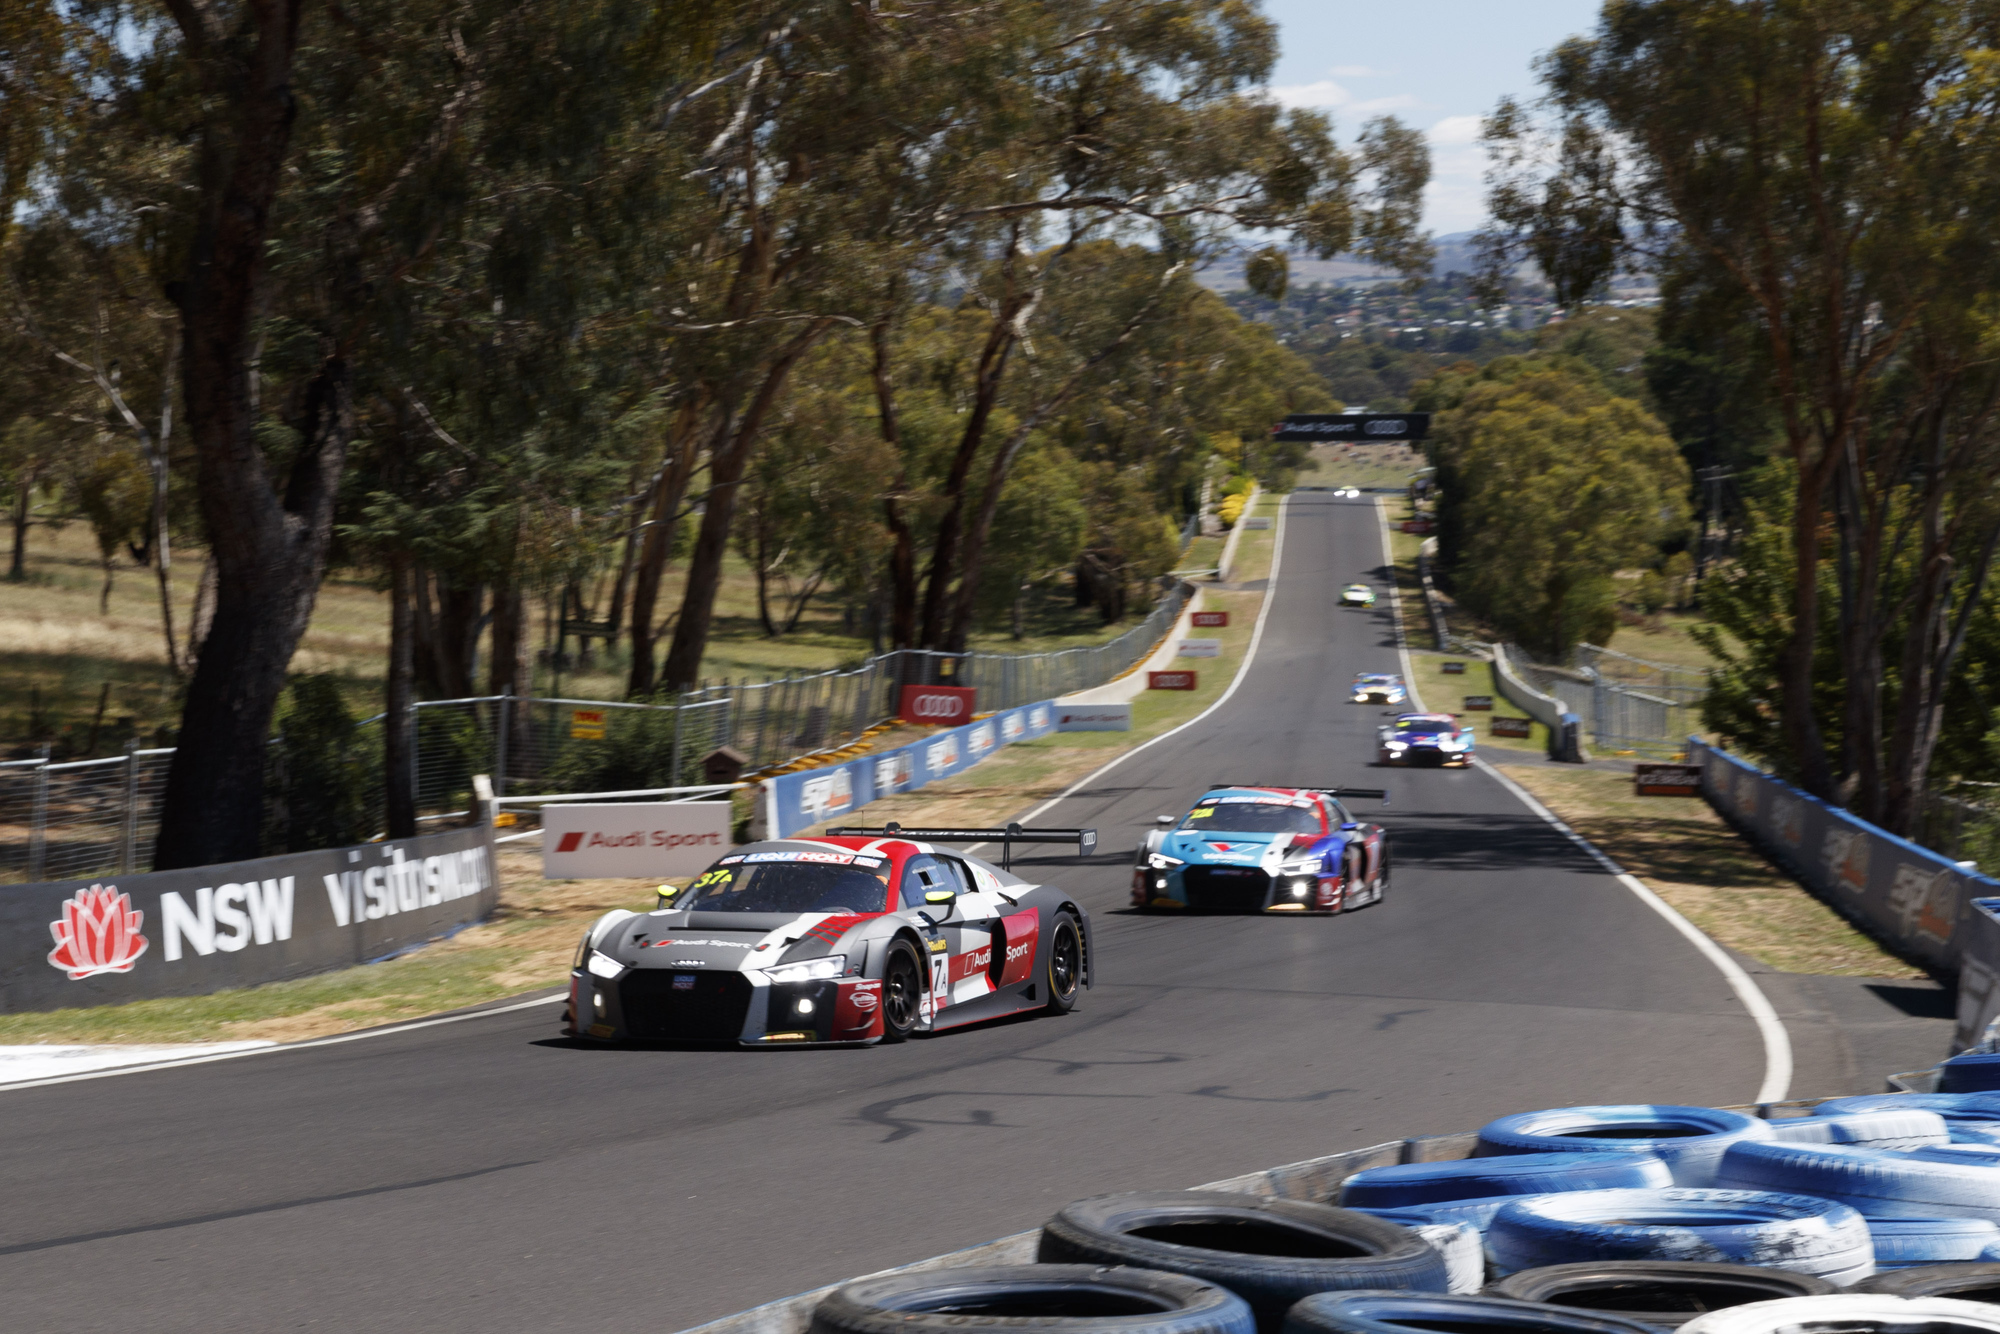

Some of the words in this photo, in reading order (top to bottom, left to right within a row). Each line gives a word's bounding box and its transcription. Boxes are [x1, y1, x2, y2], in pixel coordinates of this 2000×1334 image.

[587, 831, 646, 848] Audi
[650, 830, 722, 850] Sport
[751, 852, 799, 863] LIQUI
[798, 853, 848, 864] MOLY
[160, 875, 296, 962] NSW
[974, 948, 992, 967] Audi
[1006, 941, 1029, 962] Sport
